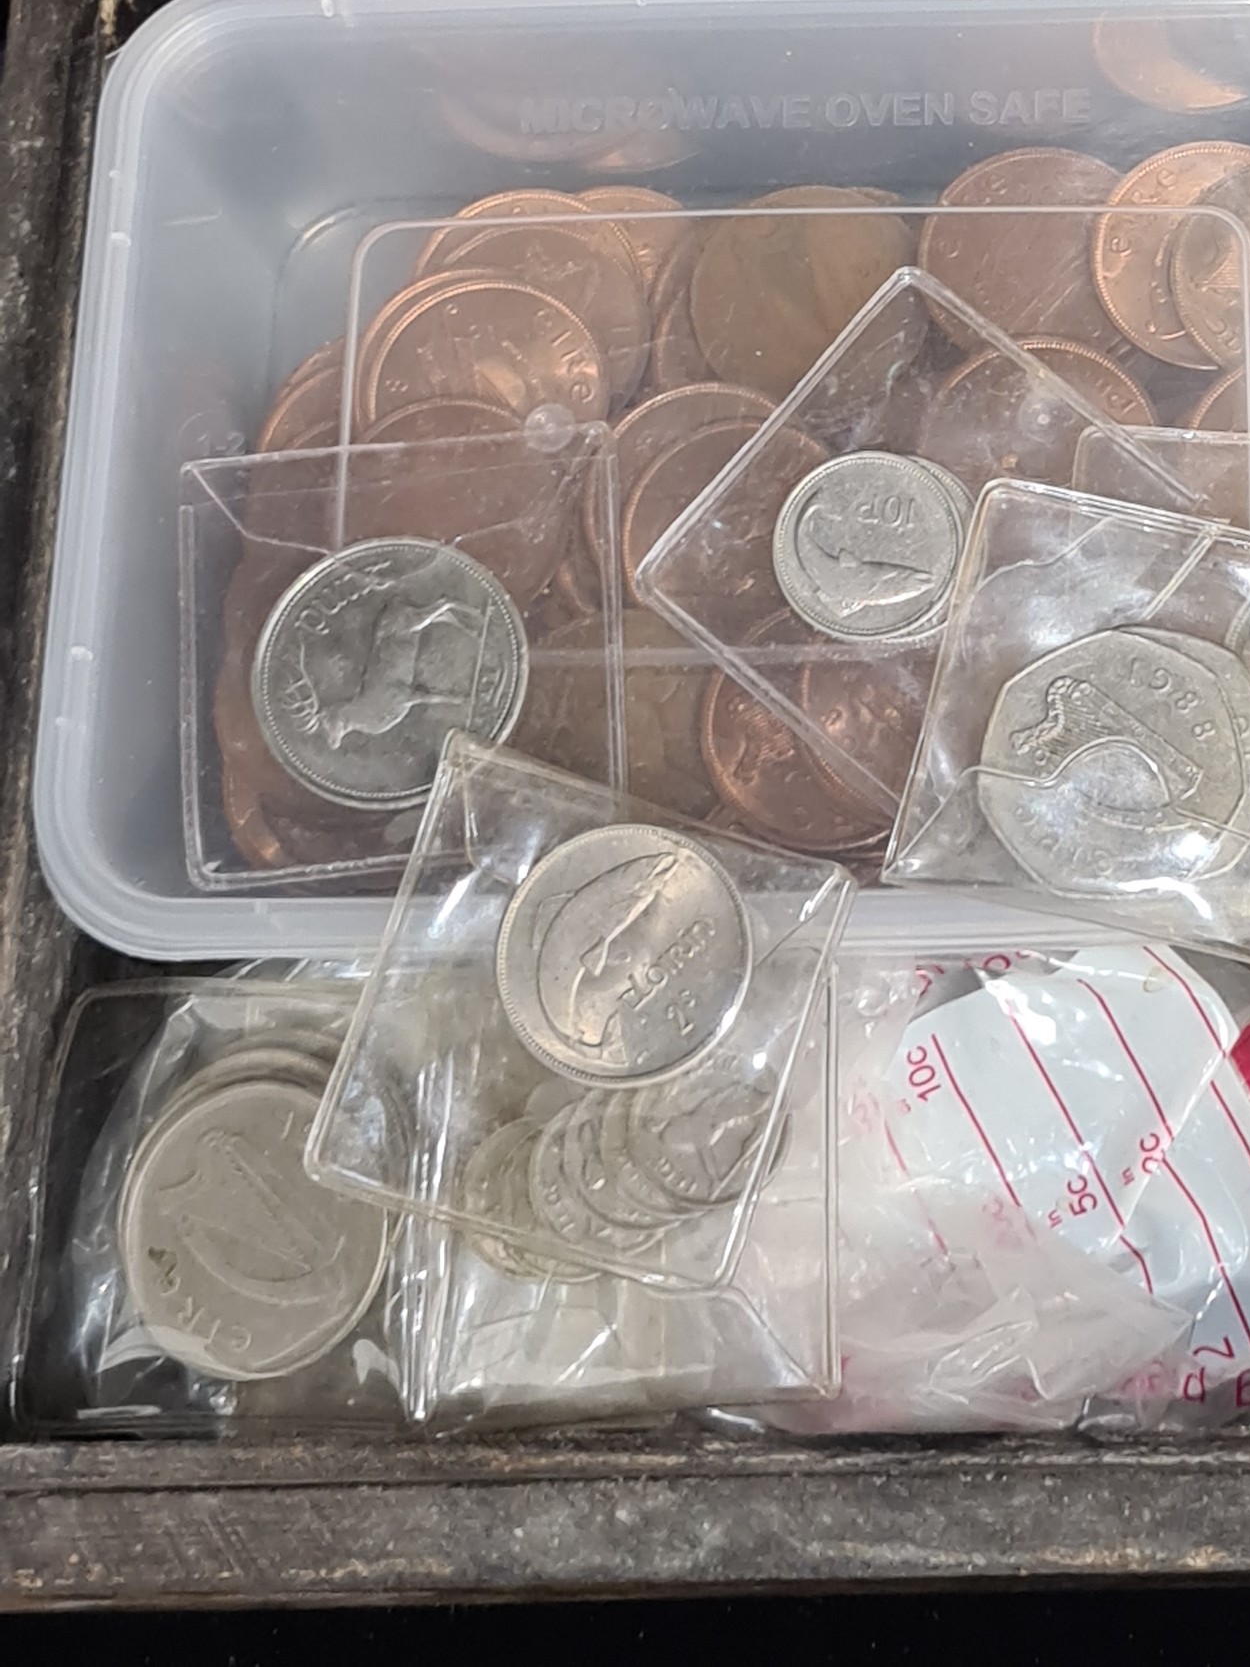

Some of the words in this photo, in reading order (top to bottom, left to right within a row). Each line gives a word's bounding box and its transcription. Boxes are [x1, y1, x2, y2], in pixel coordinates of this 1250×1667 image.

[520, 93, 812, 134] MICROWAVE
[824, 90, 953, 129] OVEN
[968, 87, 1092, 126] SAFE
[906, 1045, 942, 1102] 10c
[1066, 1174, 1098, 1217] 5c
